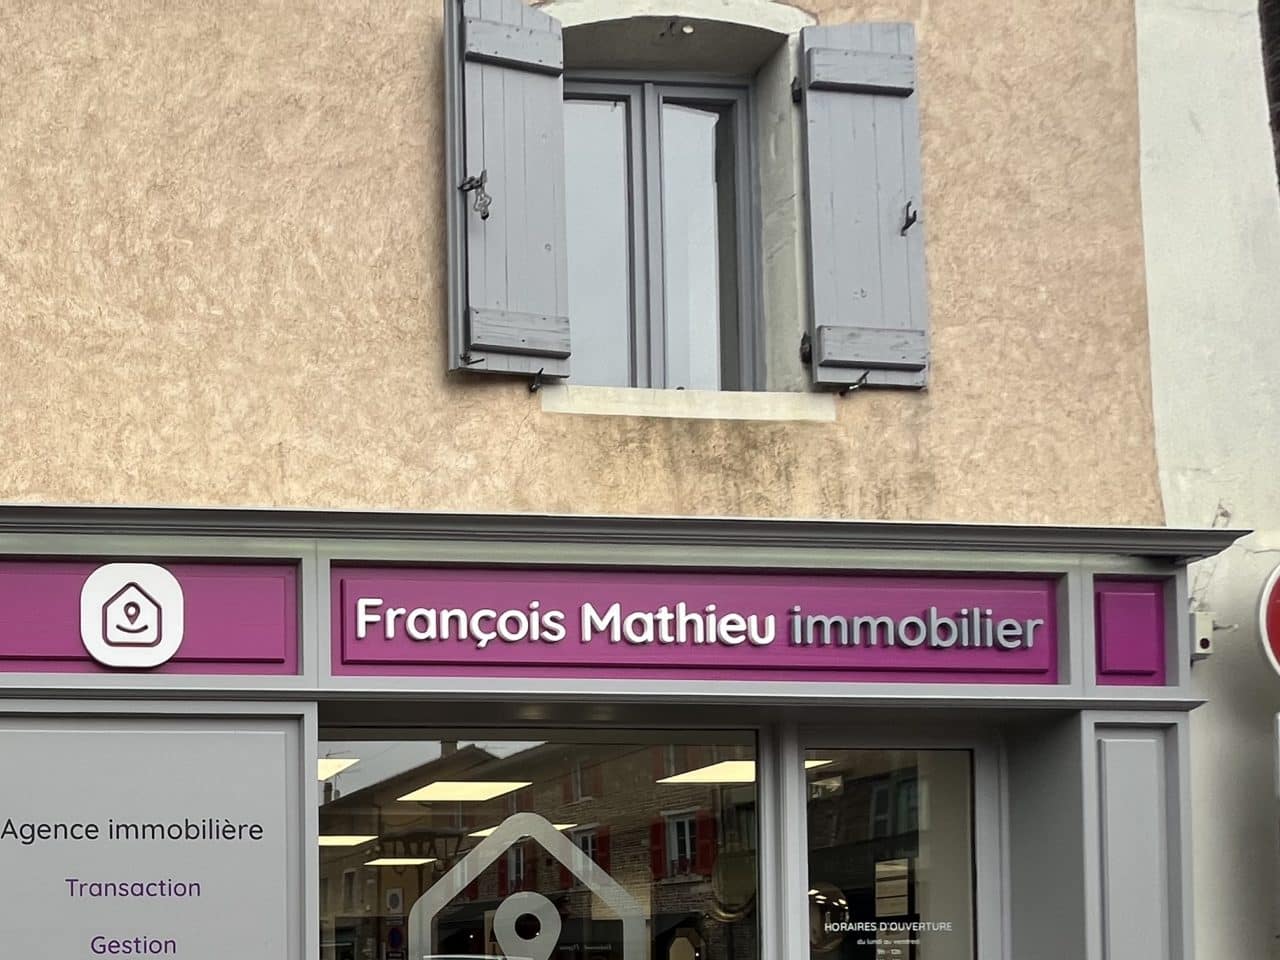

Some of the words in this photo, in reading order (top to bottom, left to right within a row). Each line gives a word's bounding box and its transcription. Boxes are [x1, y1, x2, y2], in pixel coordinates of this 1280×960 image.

[357, 598, 566, 648] François
[582, 602, 776, 645] Mathieu
[793, 604, 1044, 648] immobilier
[0, 818, 100, 846] Agence
[108, 818, 264, 841] immobilière
[65, 878, 201, 897] Transaction
[824, 921, 877, 932] HORAIRES
[879, 921, 953, 932] D'OUVERTURE
[91, 936, 177, 955] Gestion
